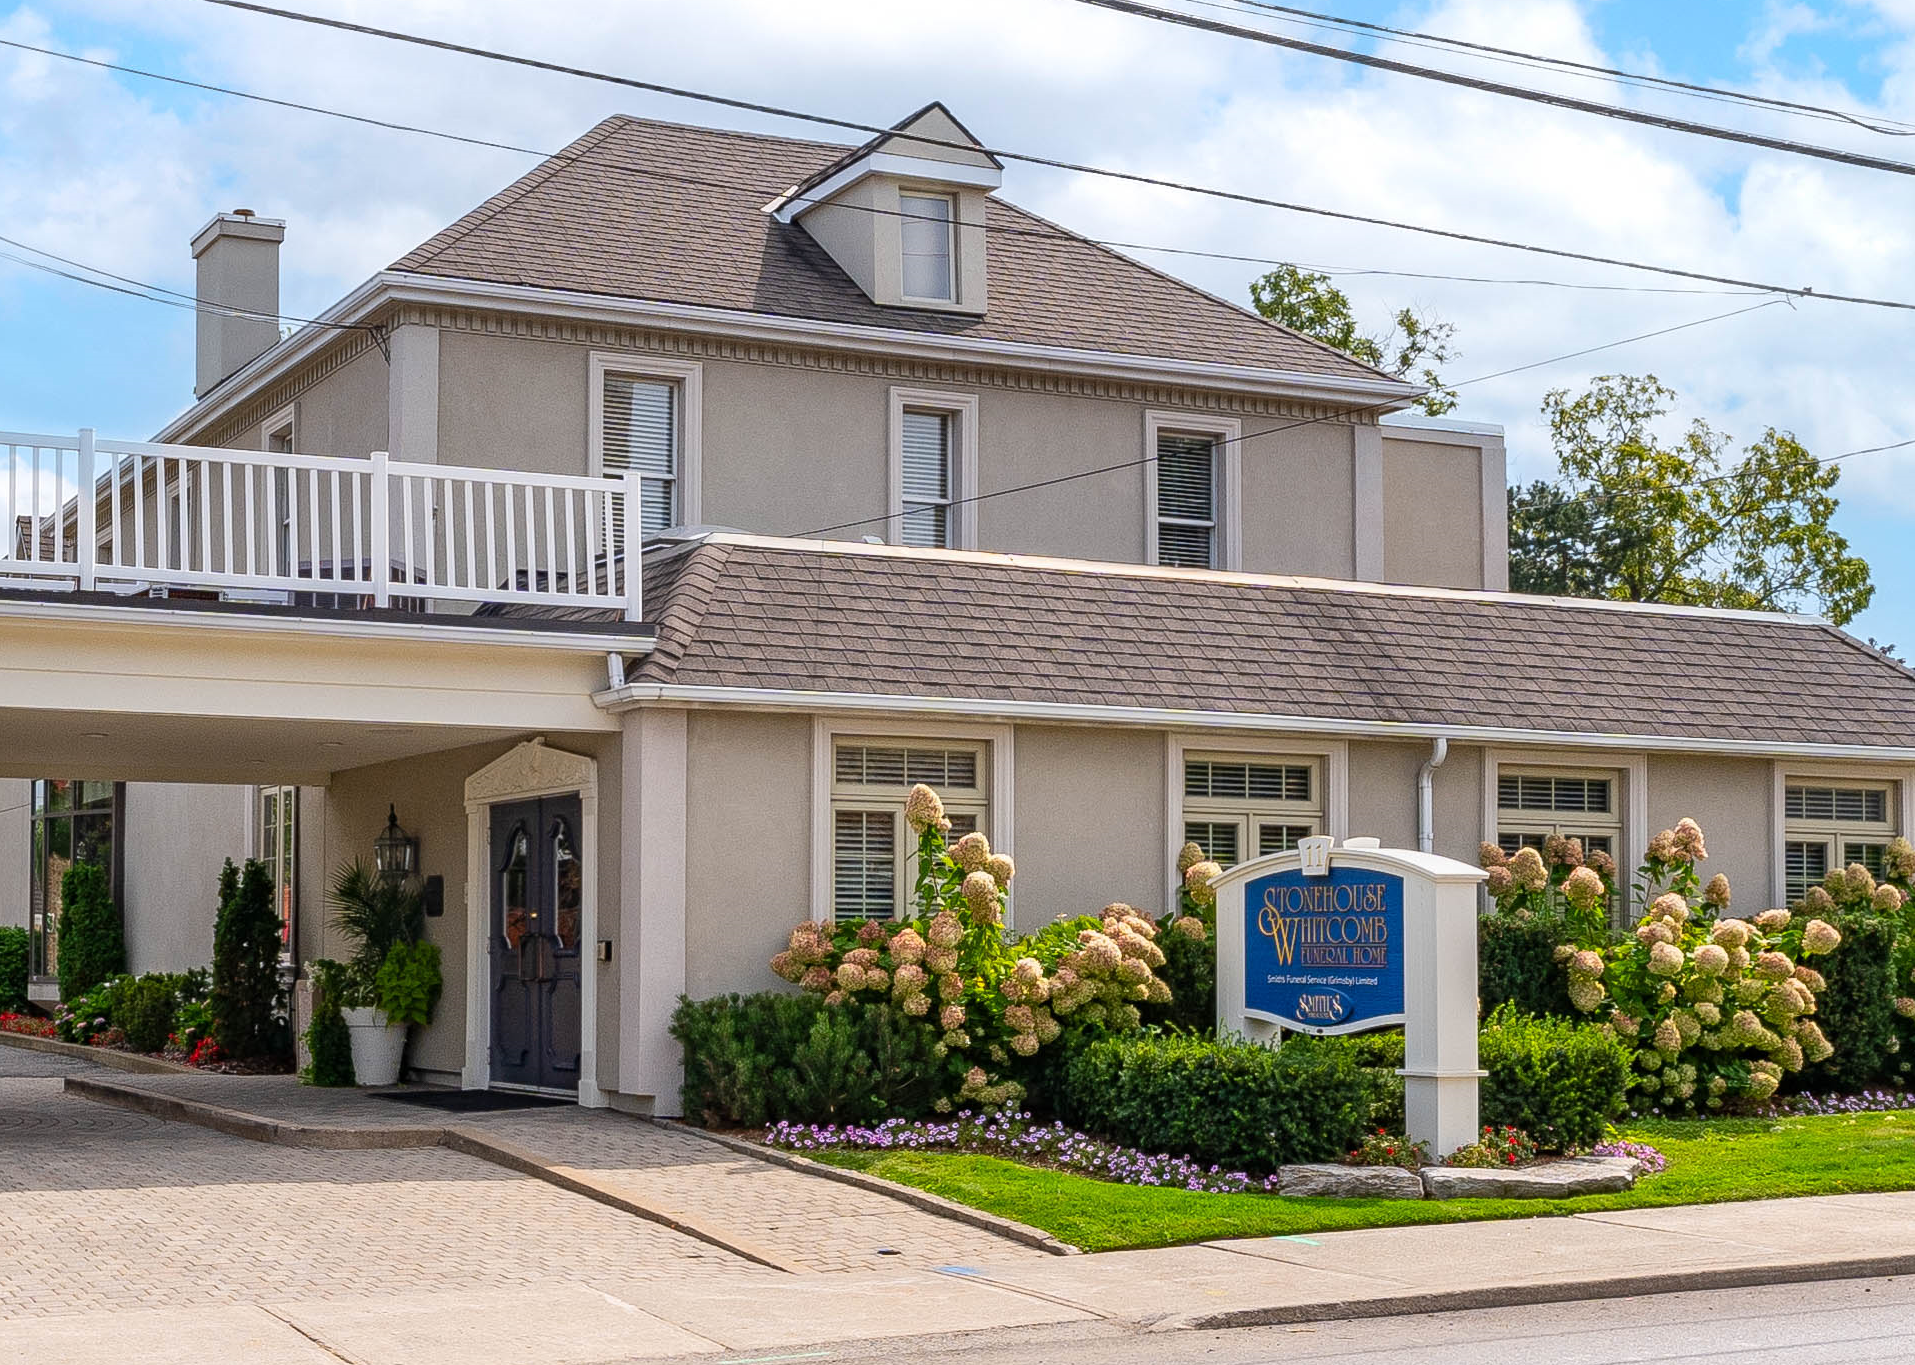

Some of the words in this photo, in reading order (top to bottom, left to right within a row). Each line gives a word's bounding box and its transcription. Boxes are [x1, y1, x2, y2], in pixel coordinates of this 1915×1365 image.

[1305, 844, 1323, 867] 11
[1258, 884, 1386, 925] STONEHOUSE
[1270, 916, 1387, 957] WHITCOMB
[1301, 947, 1349, 964] FUNERAL
[1353, 947, 1387, 964] HOME
[1286, 974, 1307, 984] Funeral
[1307, 974, 1327, 985] Service
[1328, 975, 1354, 986] (Grimsby)
[1355, 976, 1378, 985] Limited
